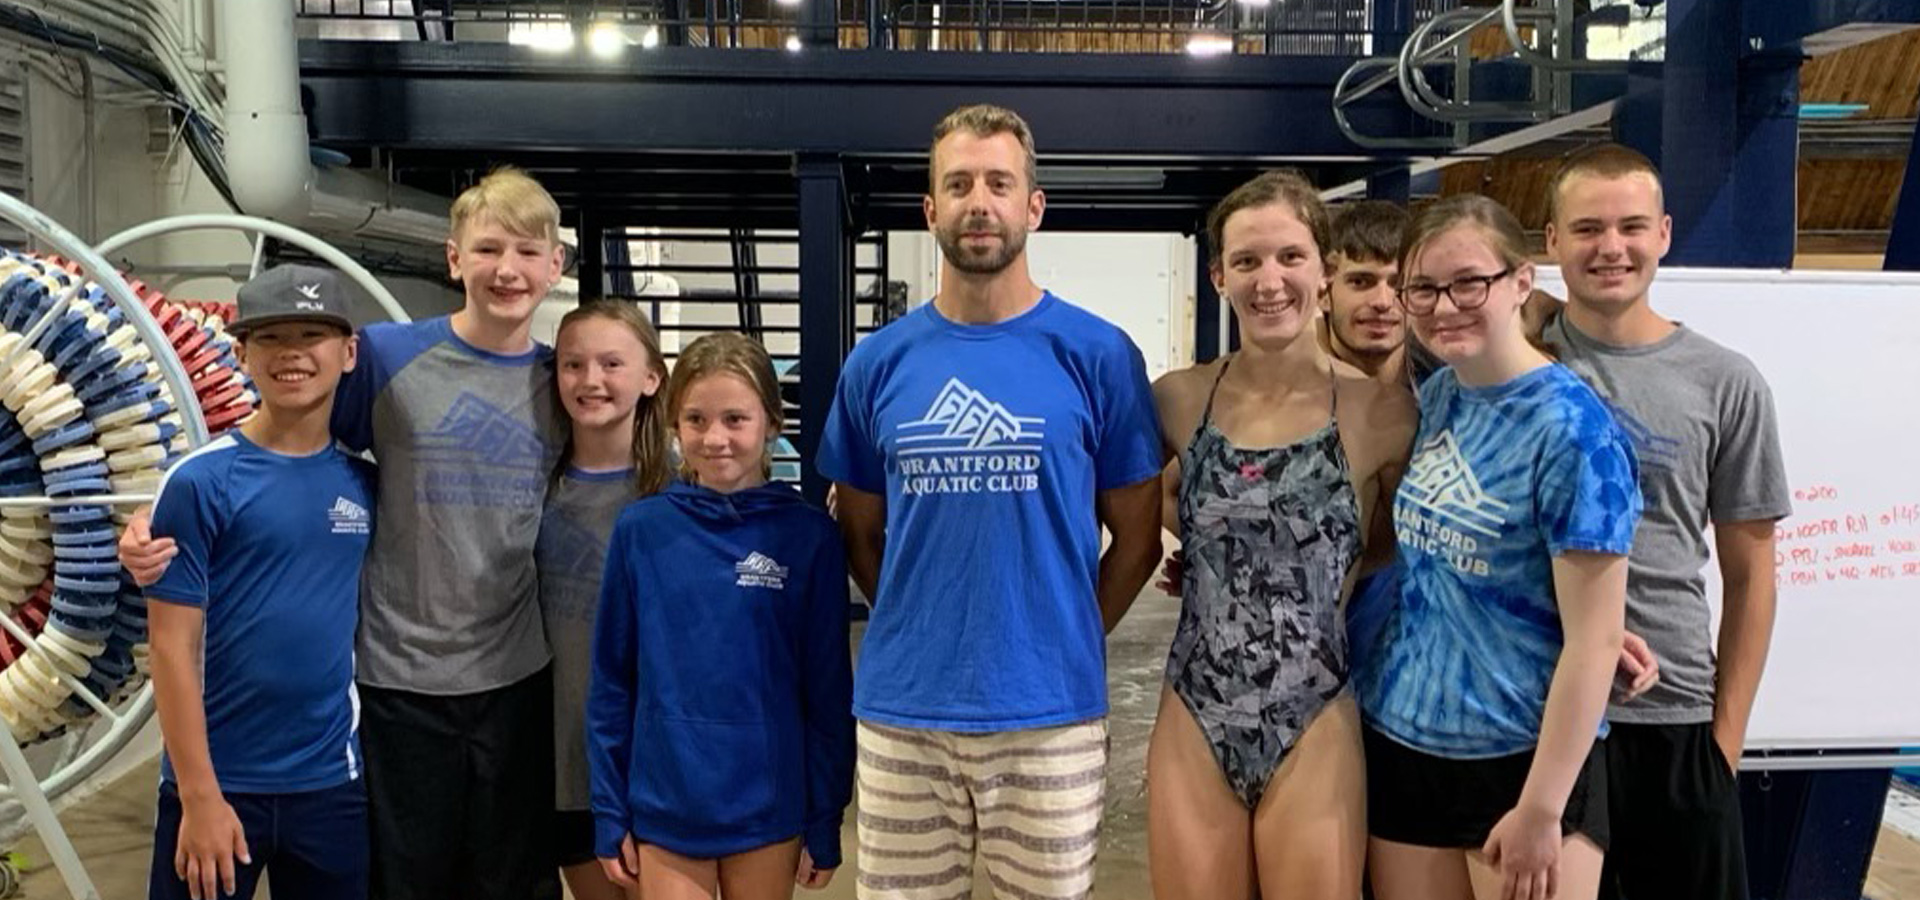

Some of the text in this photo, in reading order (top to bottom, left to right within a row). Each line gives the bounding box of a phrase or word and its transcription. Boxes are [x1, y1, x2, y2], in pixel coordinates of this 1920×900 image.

[900, 454, 1041, 475] BRANTFORD
[904, 474, 1039, 496] AQUATIC CLUB
